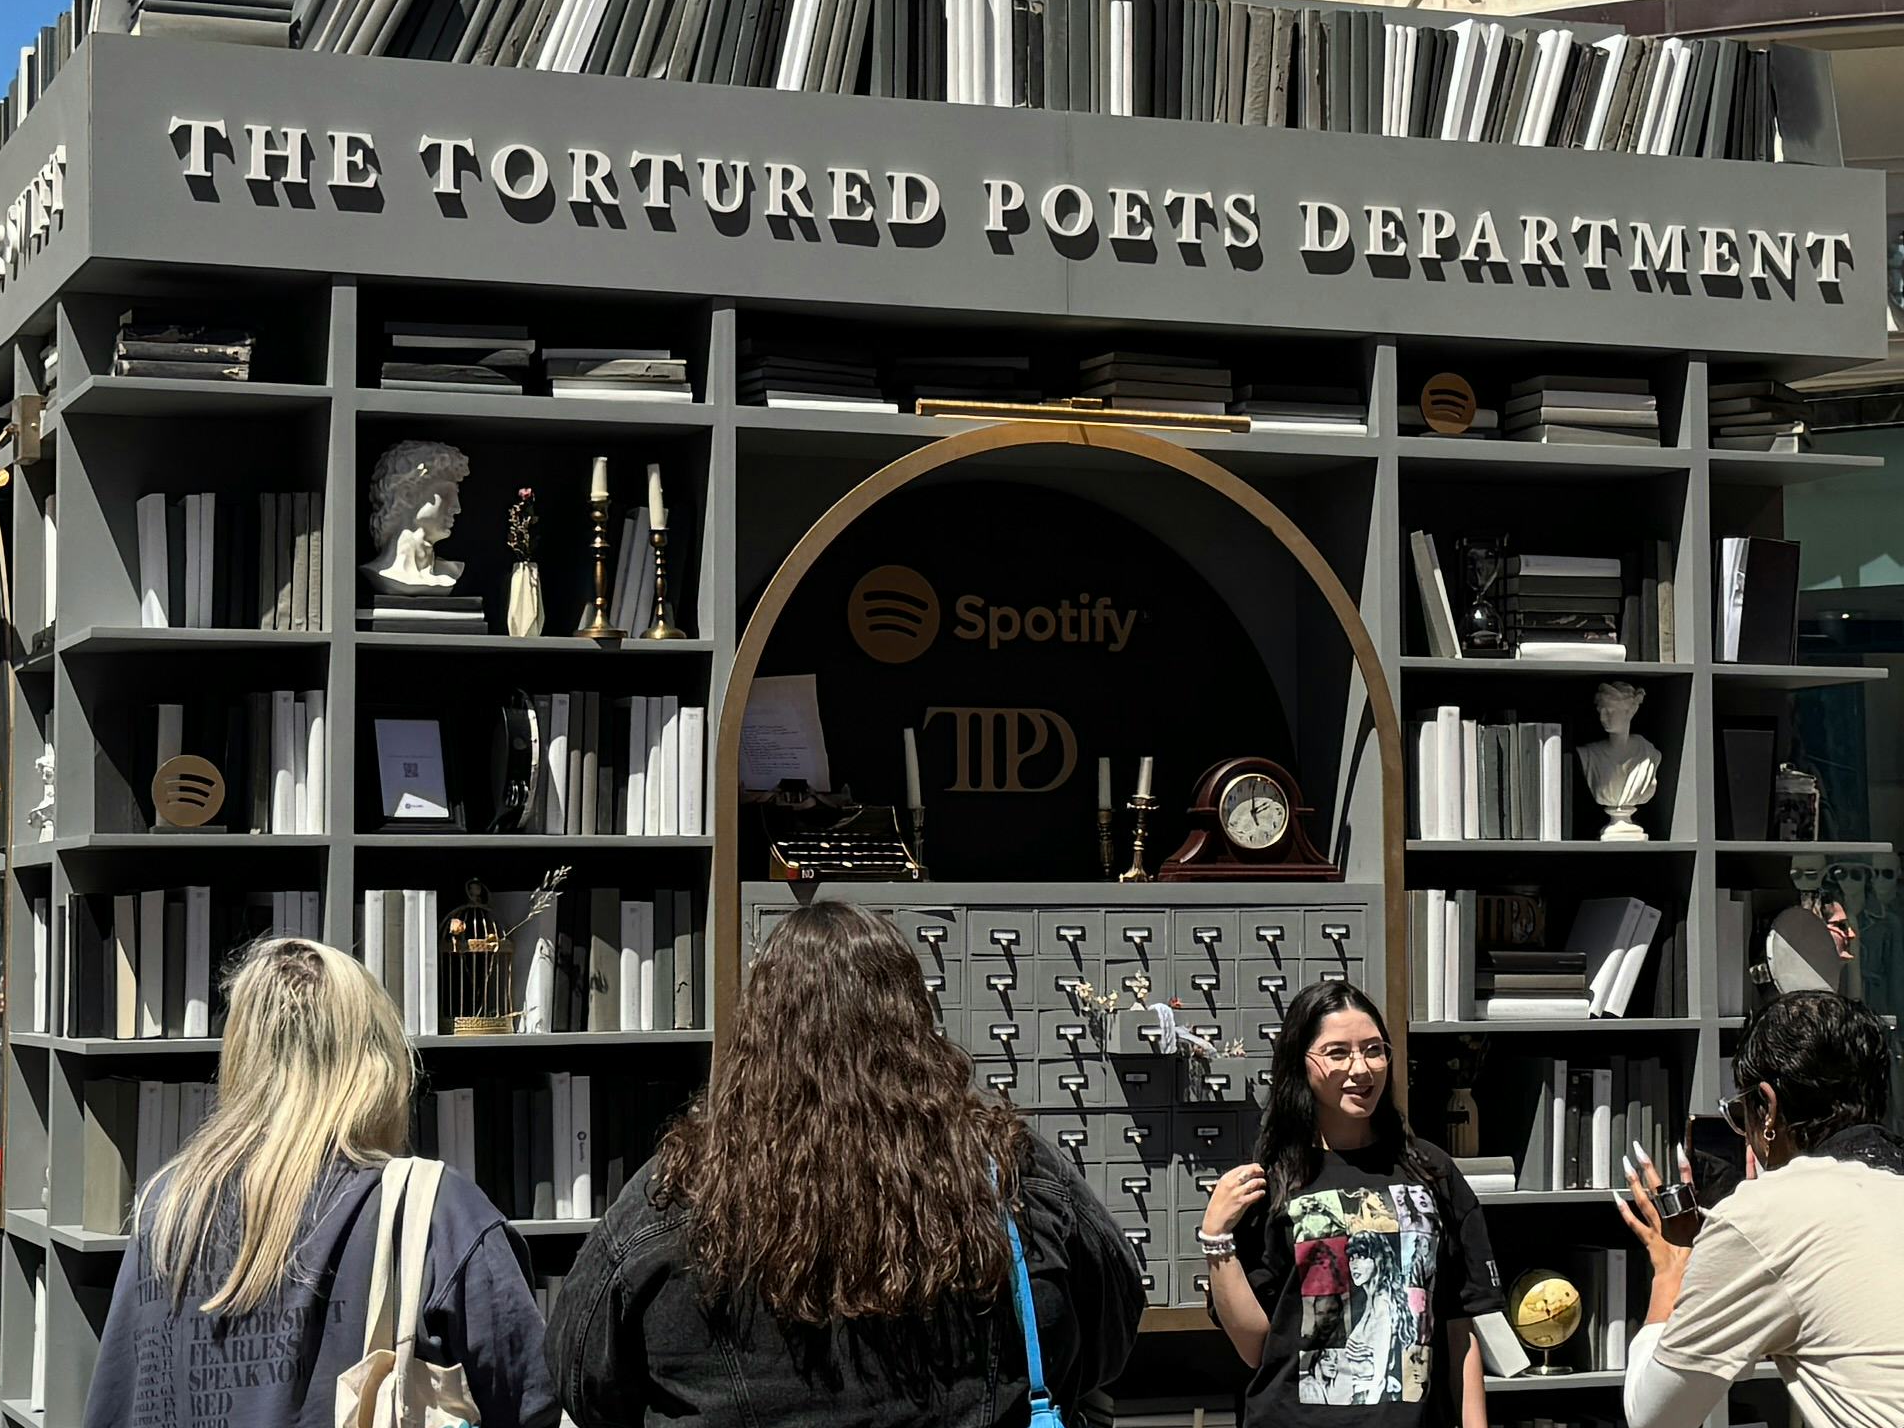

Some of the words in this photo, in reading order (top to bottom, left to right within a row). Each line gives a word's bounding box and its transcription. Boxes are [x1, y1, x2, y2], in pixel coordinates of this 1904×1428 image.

[168, 115, 379, 188] THE
[418, 133, 941, 225] TORTURED
[983, 178, 1260, 248] POETS
[1299, 200, 1852, 283] DEPARTMENT
[953, 593, 1137, 652] Spotify
[190, 1334, 301, 1367] FEARLESS
[189, 1364, 260, 1392] SPEAK
[190, 1392, 234, 1418] RED
